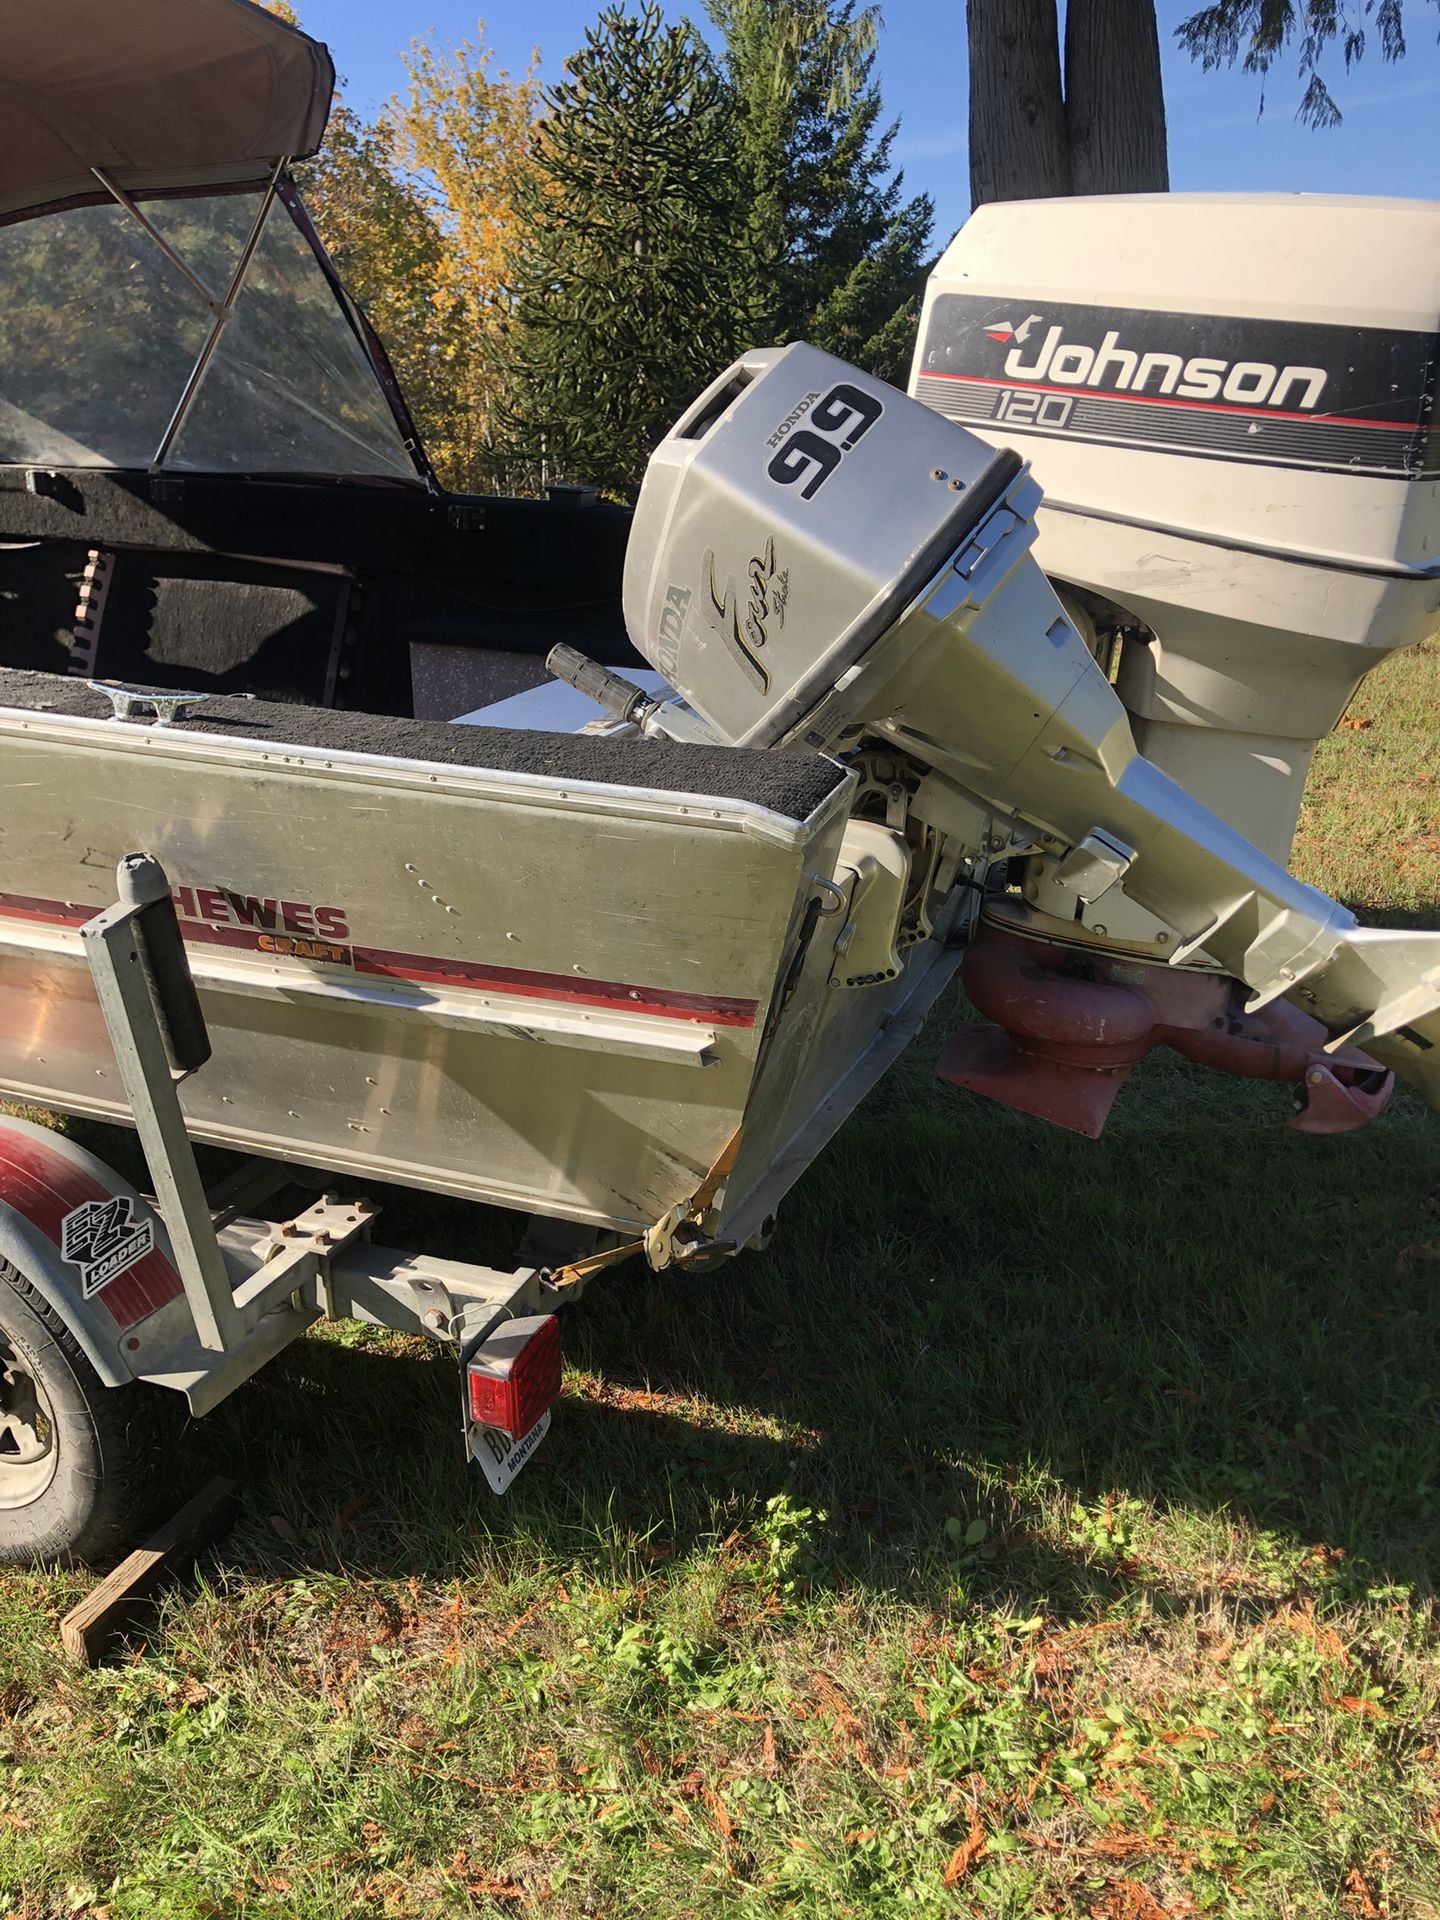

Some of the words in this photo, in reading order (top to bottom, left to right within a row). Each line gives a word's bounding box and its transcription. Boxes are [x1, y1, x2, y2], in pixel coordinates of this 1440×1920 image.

[1003, 325, 1328, 409] Johnson
[766, 392, 821, 448] HONDA
[996, 390, 1074, 428] 120
[768, 384, 884, 500] 9.9
[171, 885, 350, 939] HEWES
[258, 934, 345, 962] CRAFT
[64, 1197, 136, 1263] EZ
[91, 1231, 150, 1283] LOADER
[507, 1423, 544, 1473] MONTANA
